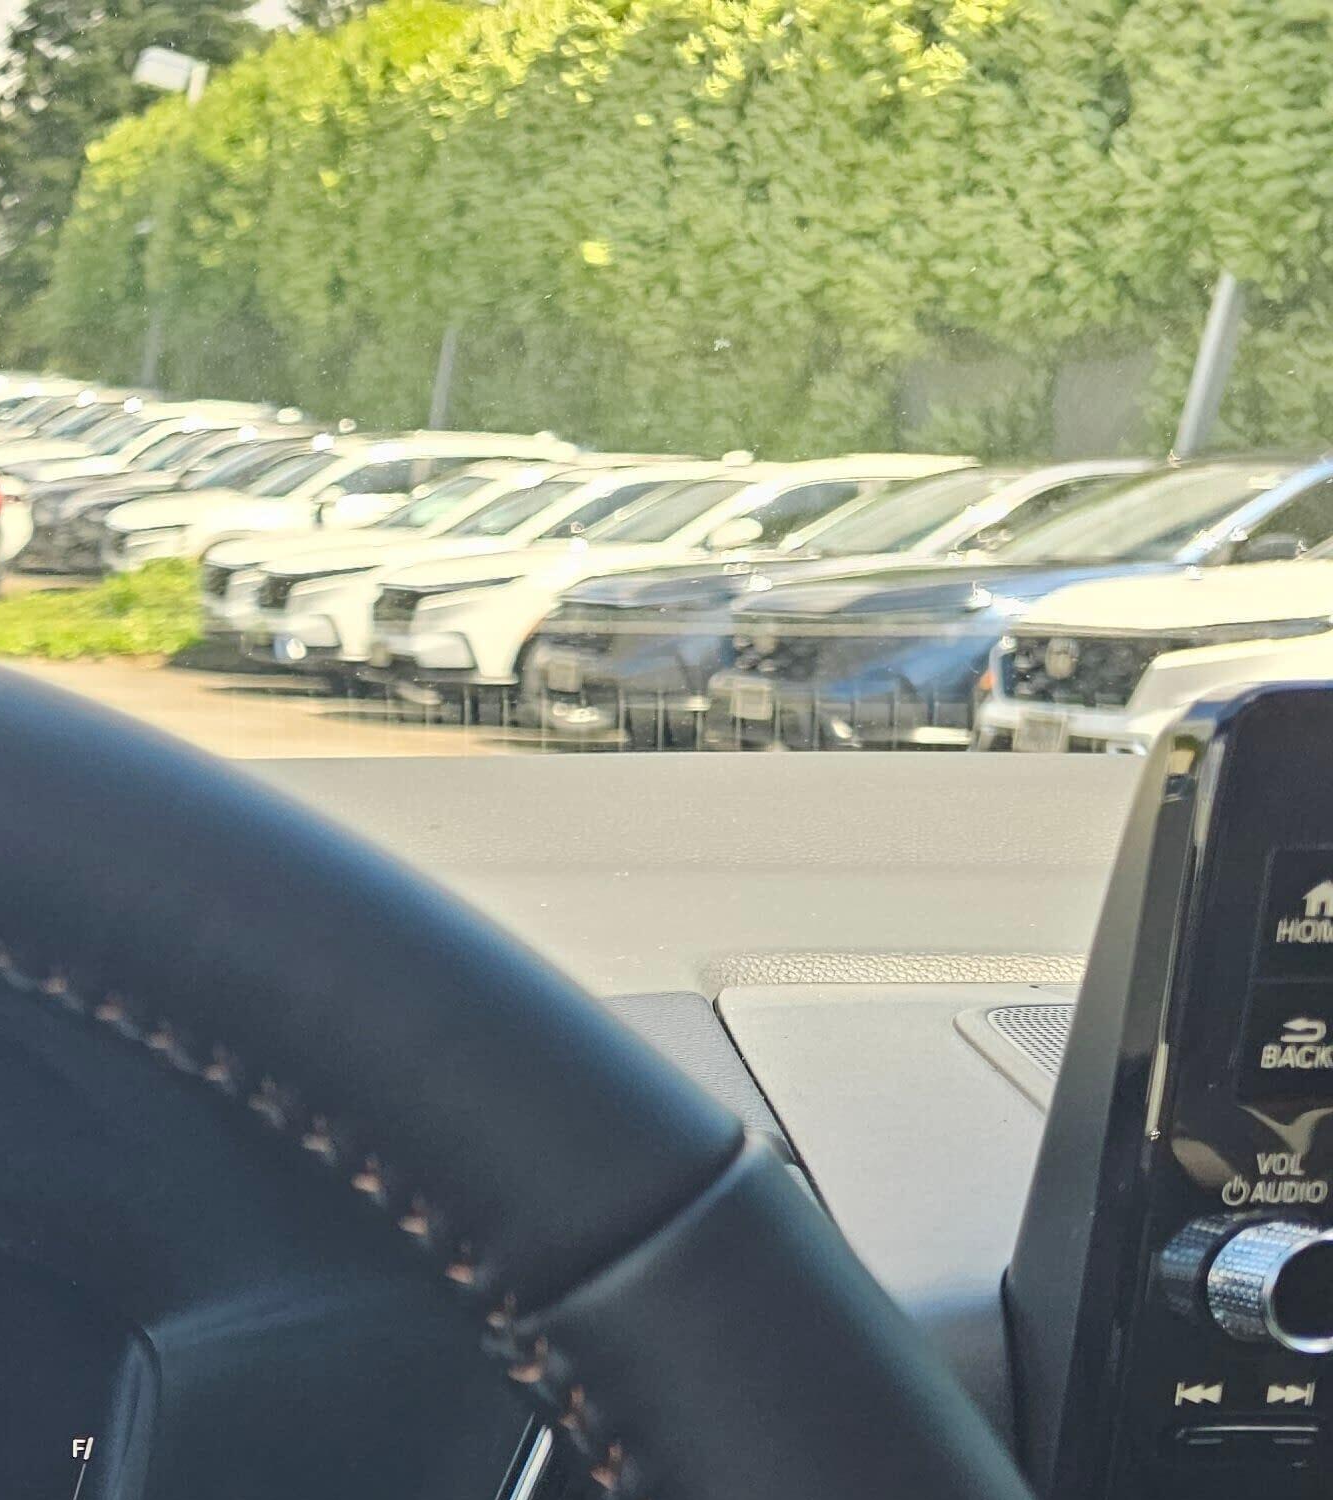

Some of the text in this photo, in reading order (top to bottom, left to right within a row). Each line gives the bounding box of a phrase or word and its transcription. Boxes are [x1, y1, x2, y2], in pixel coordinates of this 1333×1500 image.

[1276, 918, 1333, 944] HOM
[1256, 1153, 1305, 1176] VOL
[1249, 1179, 1328, 1204] AUDIO
[72, 1438, 86, 1457] F
